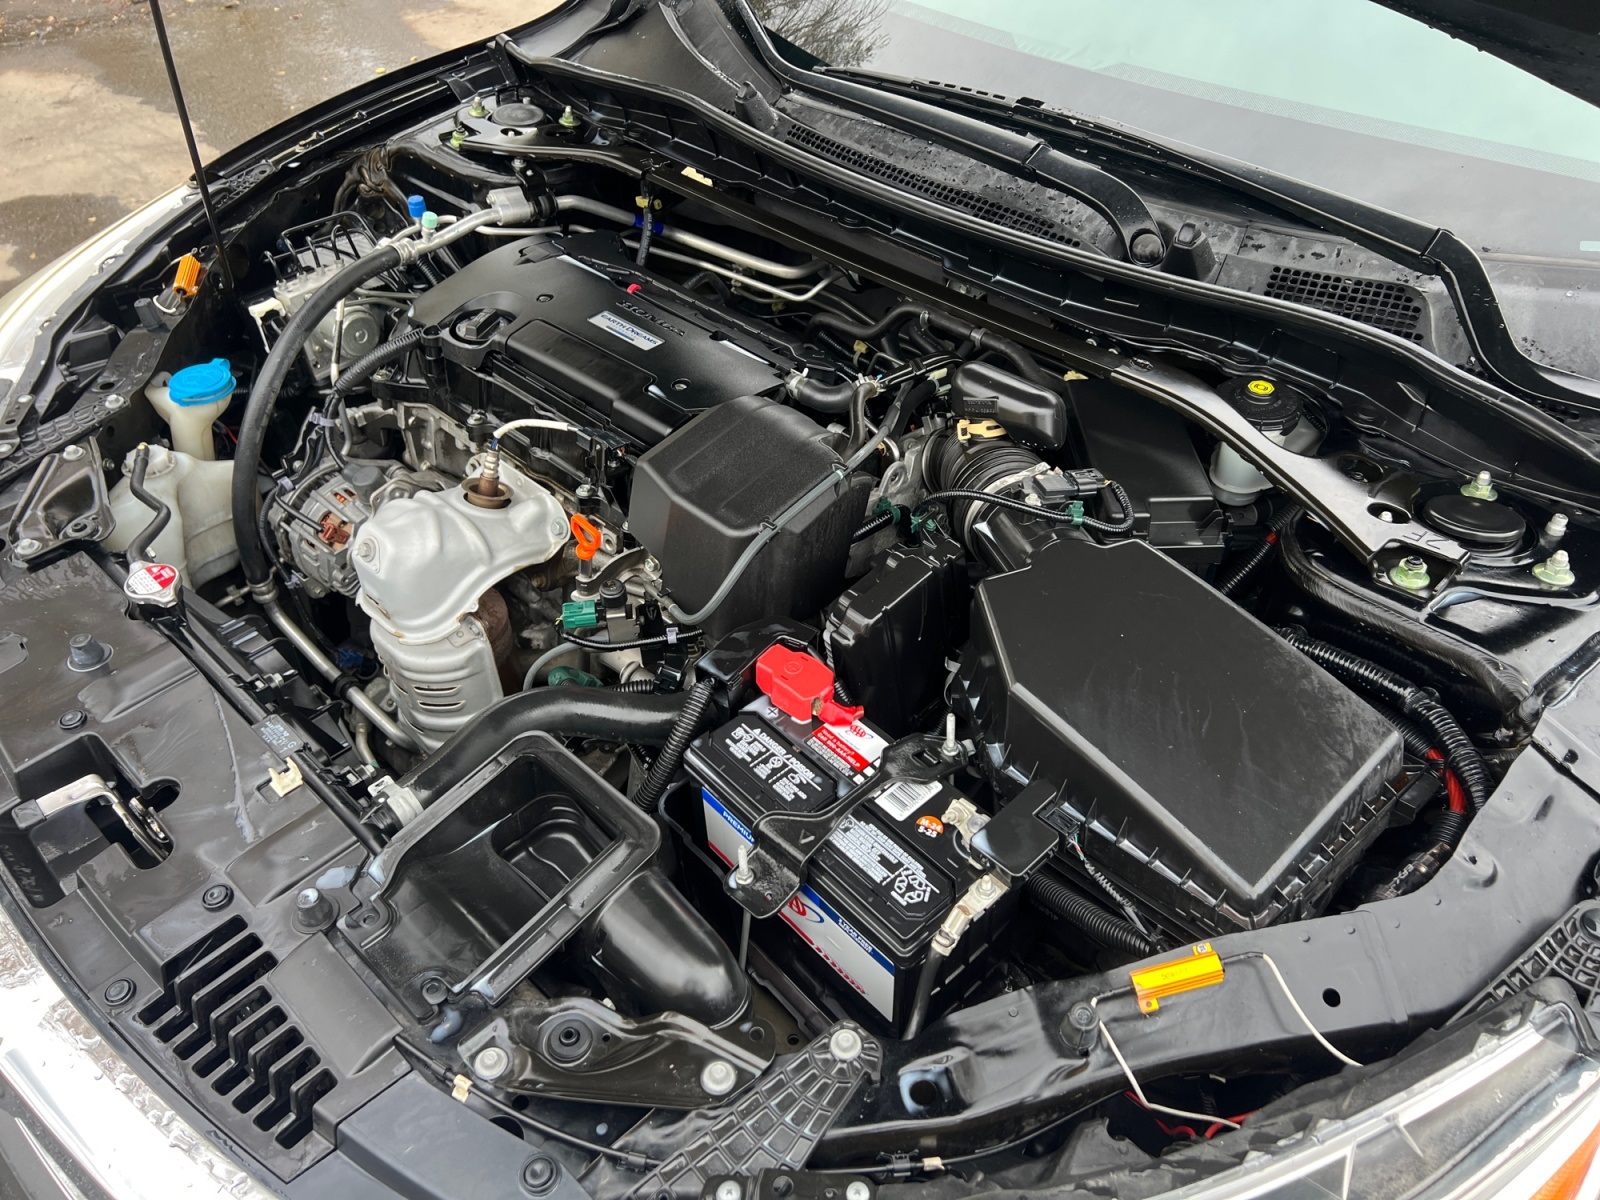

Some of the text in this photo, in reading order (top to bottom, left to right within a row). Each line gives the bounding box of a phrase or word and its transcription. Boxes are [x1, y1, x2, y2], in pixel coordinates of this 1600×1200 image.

[600, 313, 625, 328] EARTH
[625, 327, 657, 345] DREAMS
[816, 732, 827, 741] Call
[821, 729, 833, 739] Need
[758, 731, 787, 755] DANGER
[788, 756, 815, 779] POISON
[722, 810, 754, 842] PREMIU
[919, 817, 941, 830] M-24
